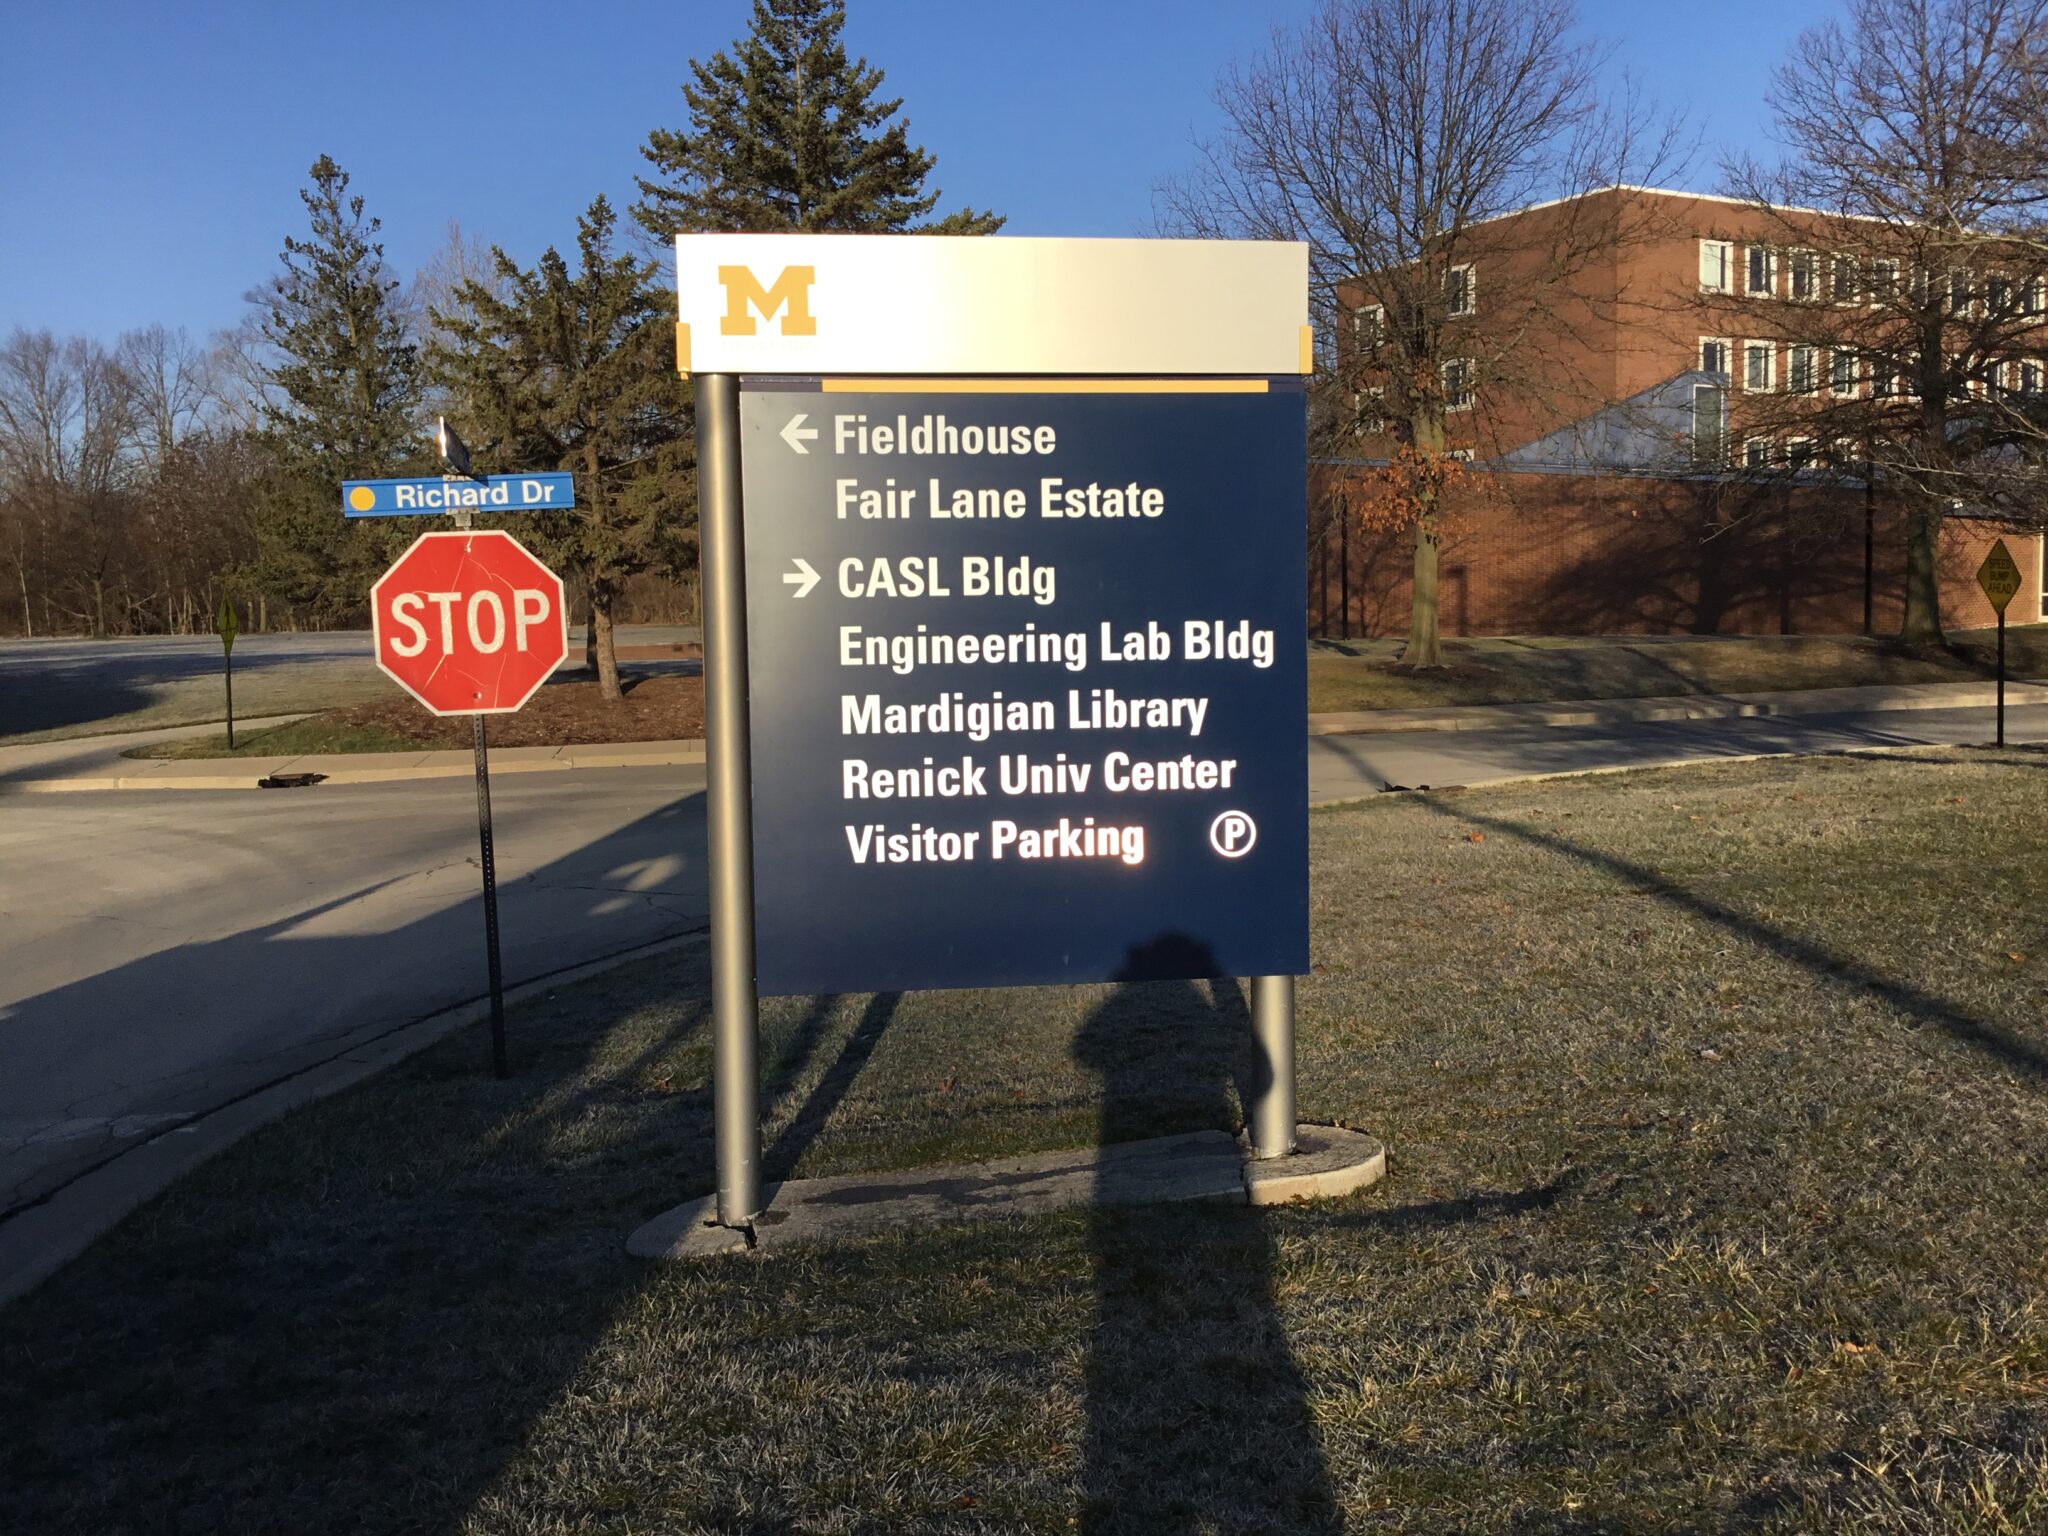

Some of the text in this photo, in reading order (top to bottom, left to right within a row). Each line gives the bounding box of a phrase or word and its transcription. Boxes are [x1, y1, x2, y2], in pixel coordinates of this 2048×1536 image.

[718, 265, 817, 336] M
[834, 414, 1056, 455] Fieldhouse
[395, 480, 555, 509] Richard Dr
[836, 477, 1165, 520] Fair Lane Estate
[838, 556, 1056, 605] CASL Bldg
[1988, 558, 2011, 570] SPEED
[1988, 582, 2013, 594] AHEAD
[389, 589, 550, 658] STOP
[839, 620, 1275, 675] Engineering Lab Bldg
[841, 689, 1209, 741] Mardigian Library
[842, 751, 1237, 799] Renick Univ Center
[844, 817, 1146, 865] Visitor Parking
